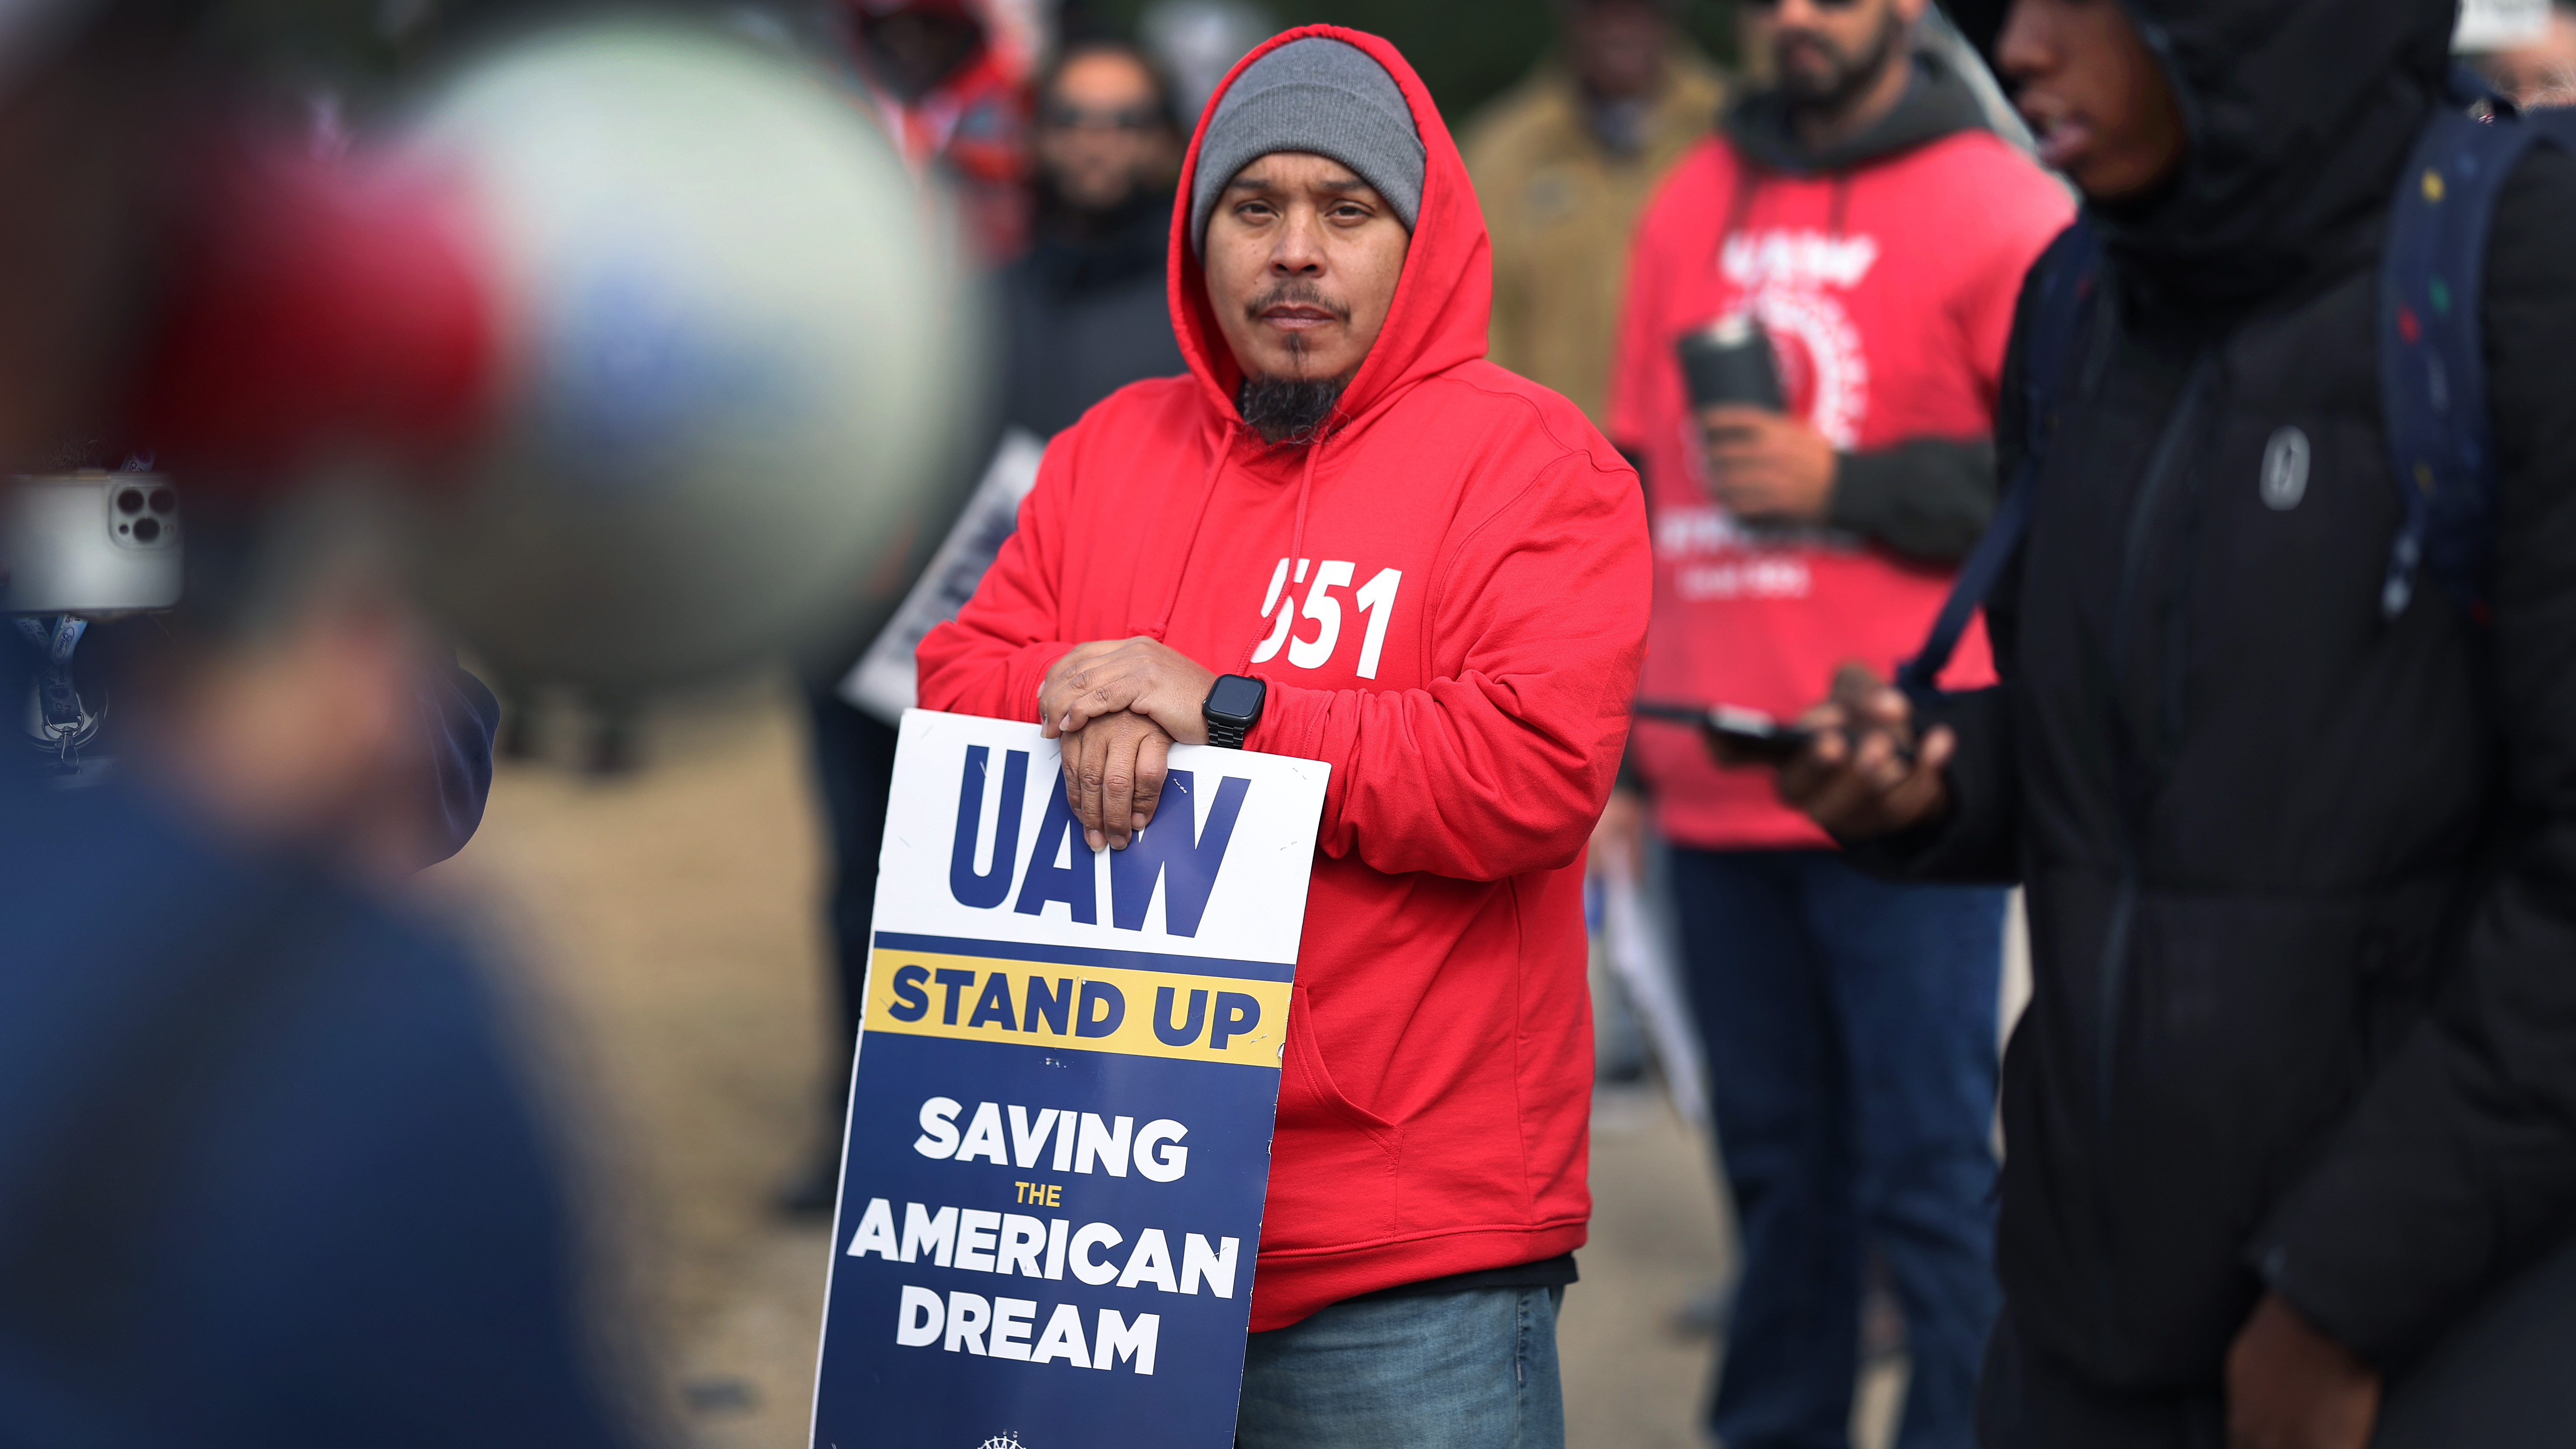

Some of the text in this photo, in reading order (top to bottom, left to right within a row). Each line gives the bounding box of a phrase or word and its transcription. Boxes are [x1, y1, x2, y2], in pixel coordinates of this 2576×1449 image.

[1250, 558, 1402, 680] 551
[950, 745, 1251, 938] UAW
[888, 965, 1261, 1050] STAND UP
[914, 1097, 1188, 1183] SAVING
[1015, 1181, 1062, 1207] THE
[847, 1198, 1240, 1299] AMERICAN
[896, 1285, 1160, 1375] DREAM
